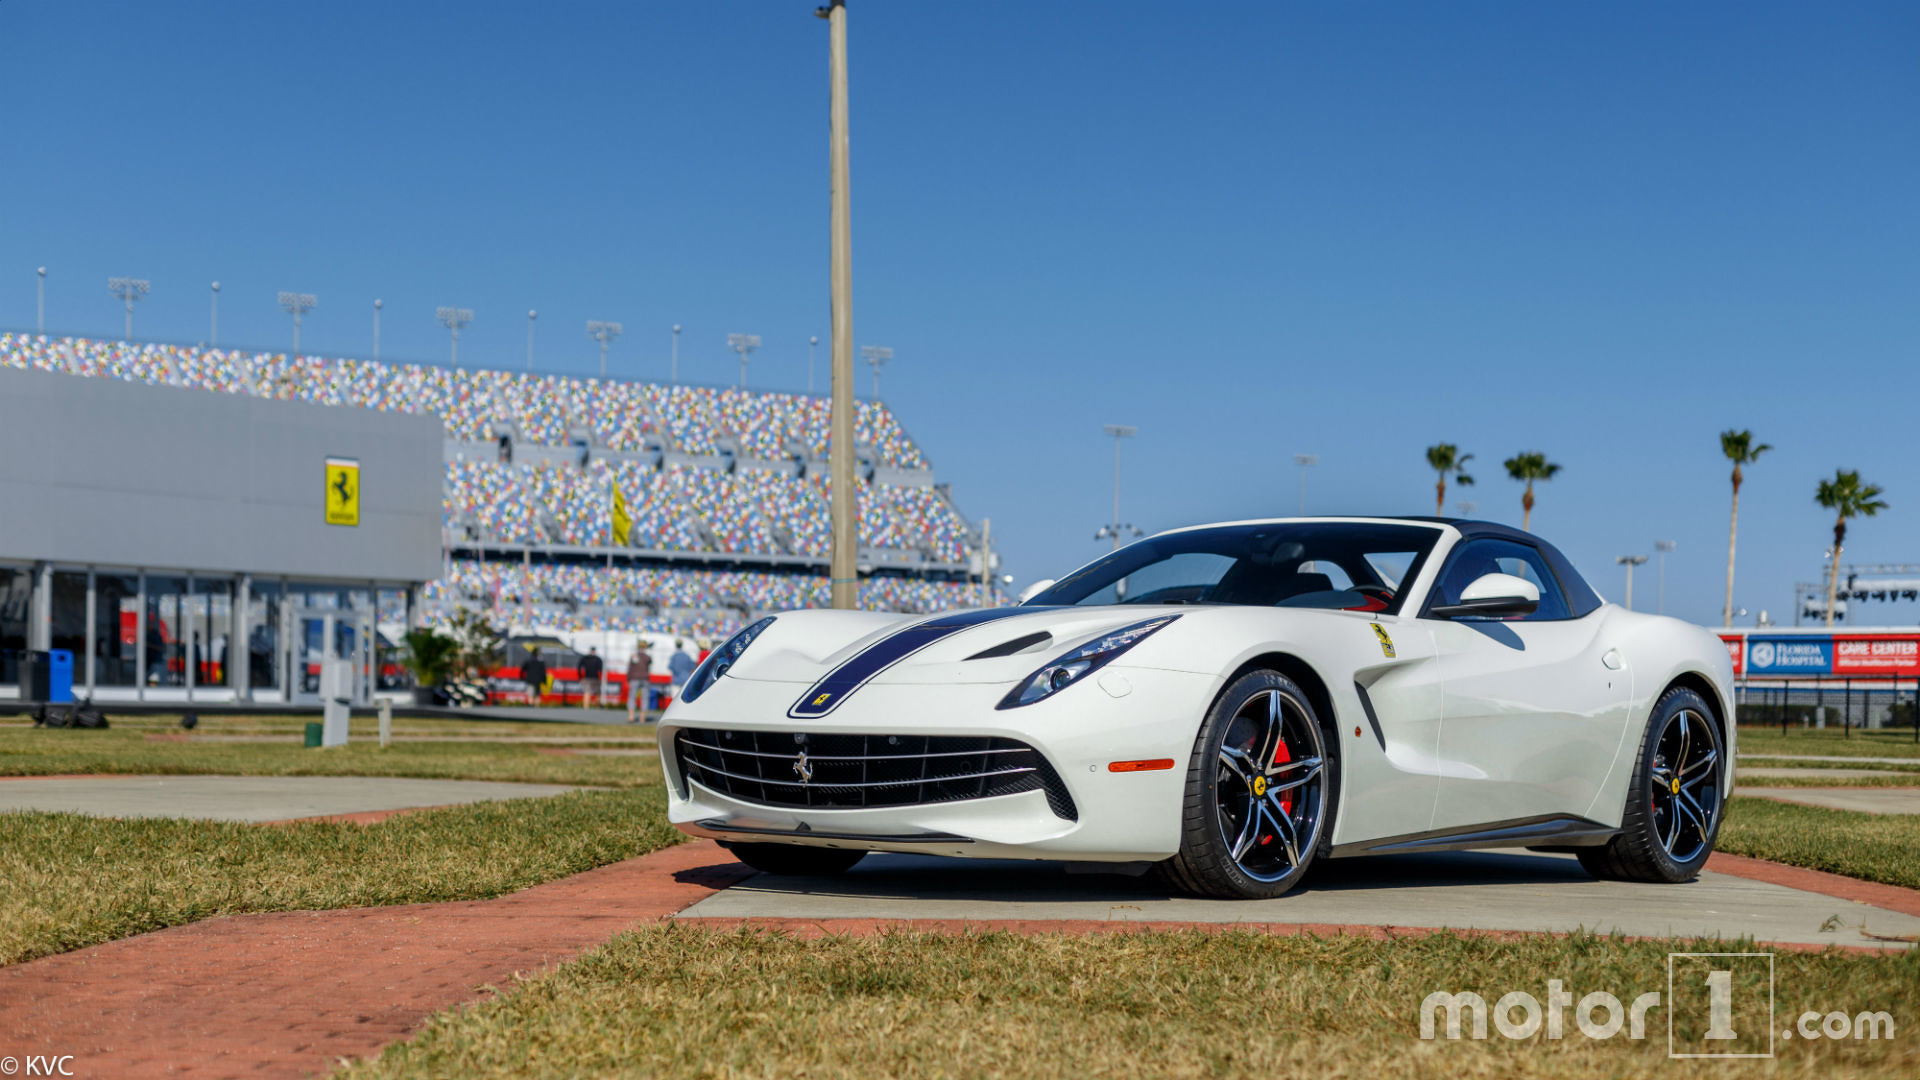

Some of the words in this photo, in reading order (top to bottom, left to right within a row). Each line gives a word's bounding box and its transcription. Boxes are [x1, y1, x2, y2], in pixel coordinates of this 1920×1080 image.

[1776, 642, 1821, 655] FLORIDA
[1838, 641, 1869, 656] CARE
[1871, 641, 1918, 656] CENTER
[1776, 655, 1827, 666] HOSPITAL
